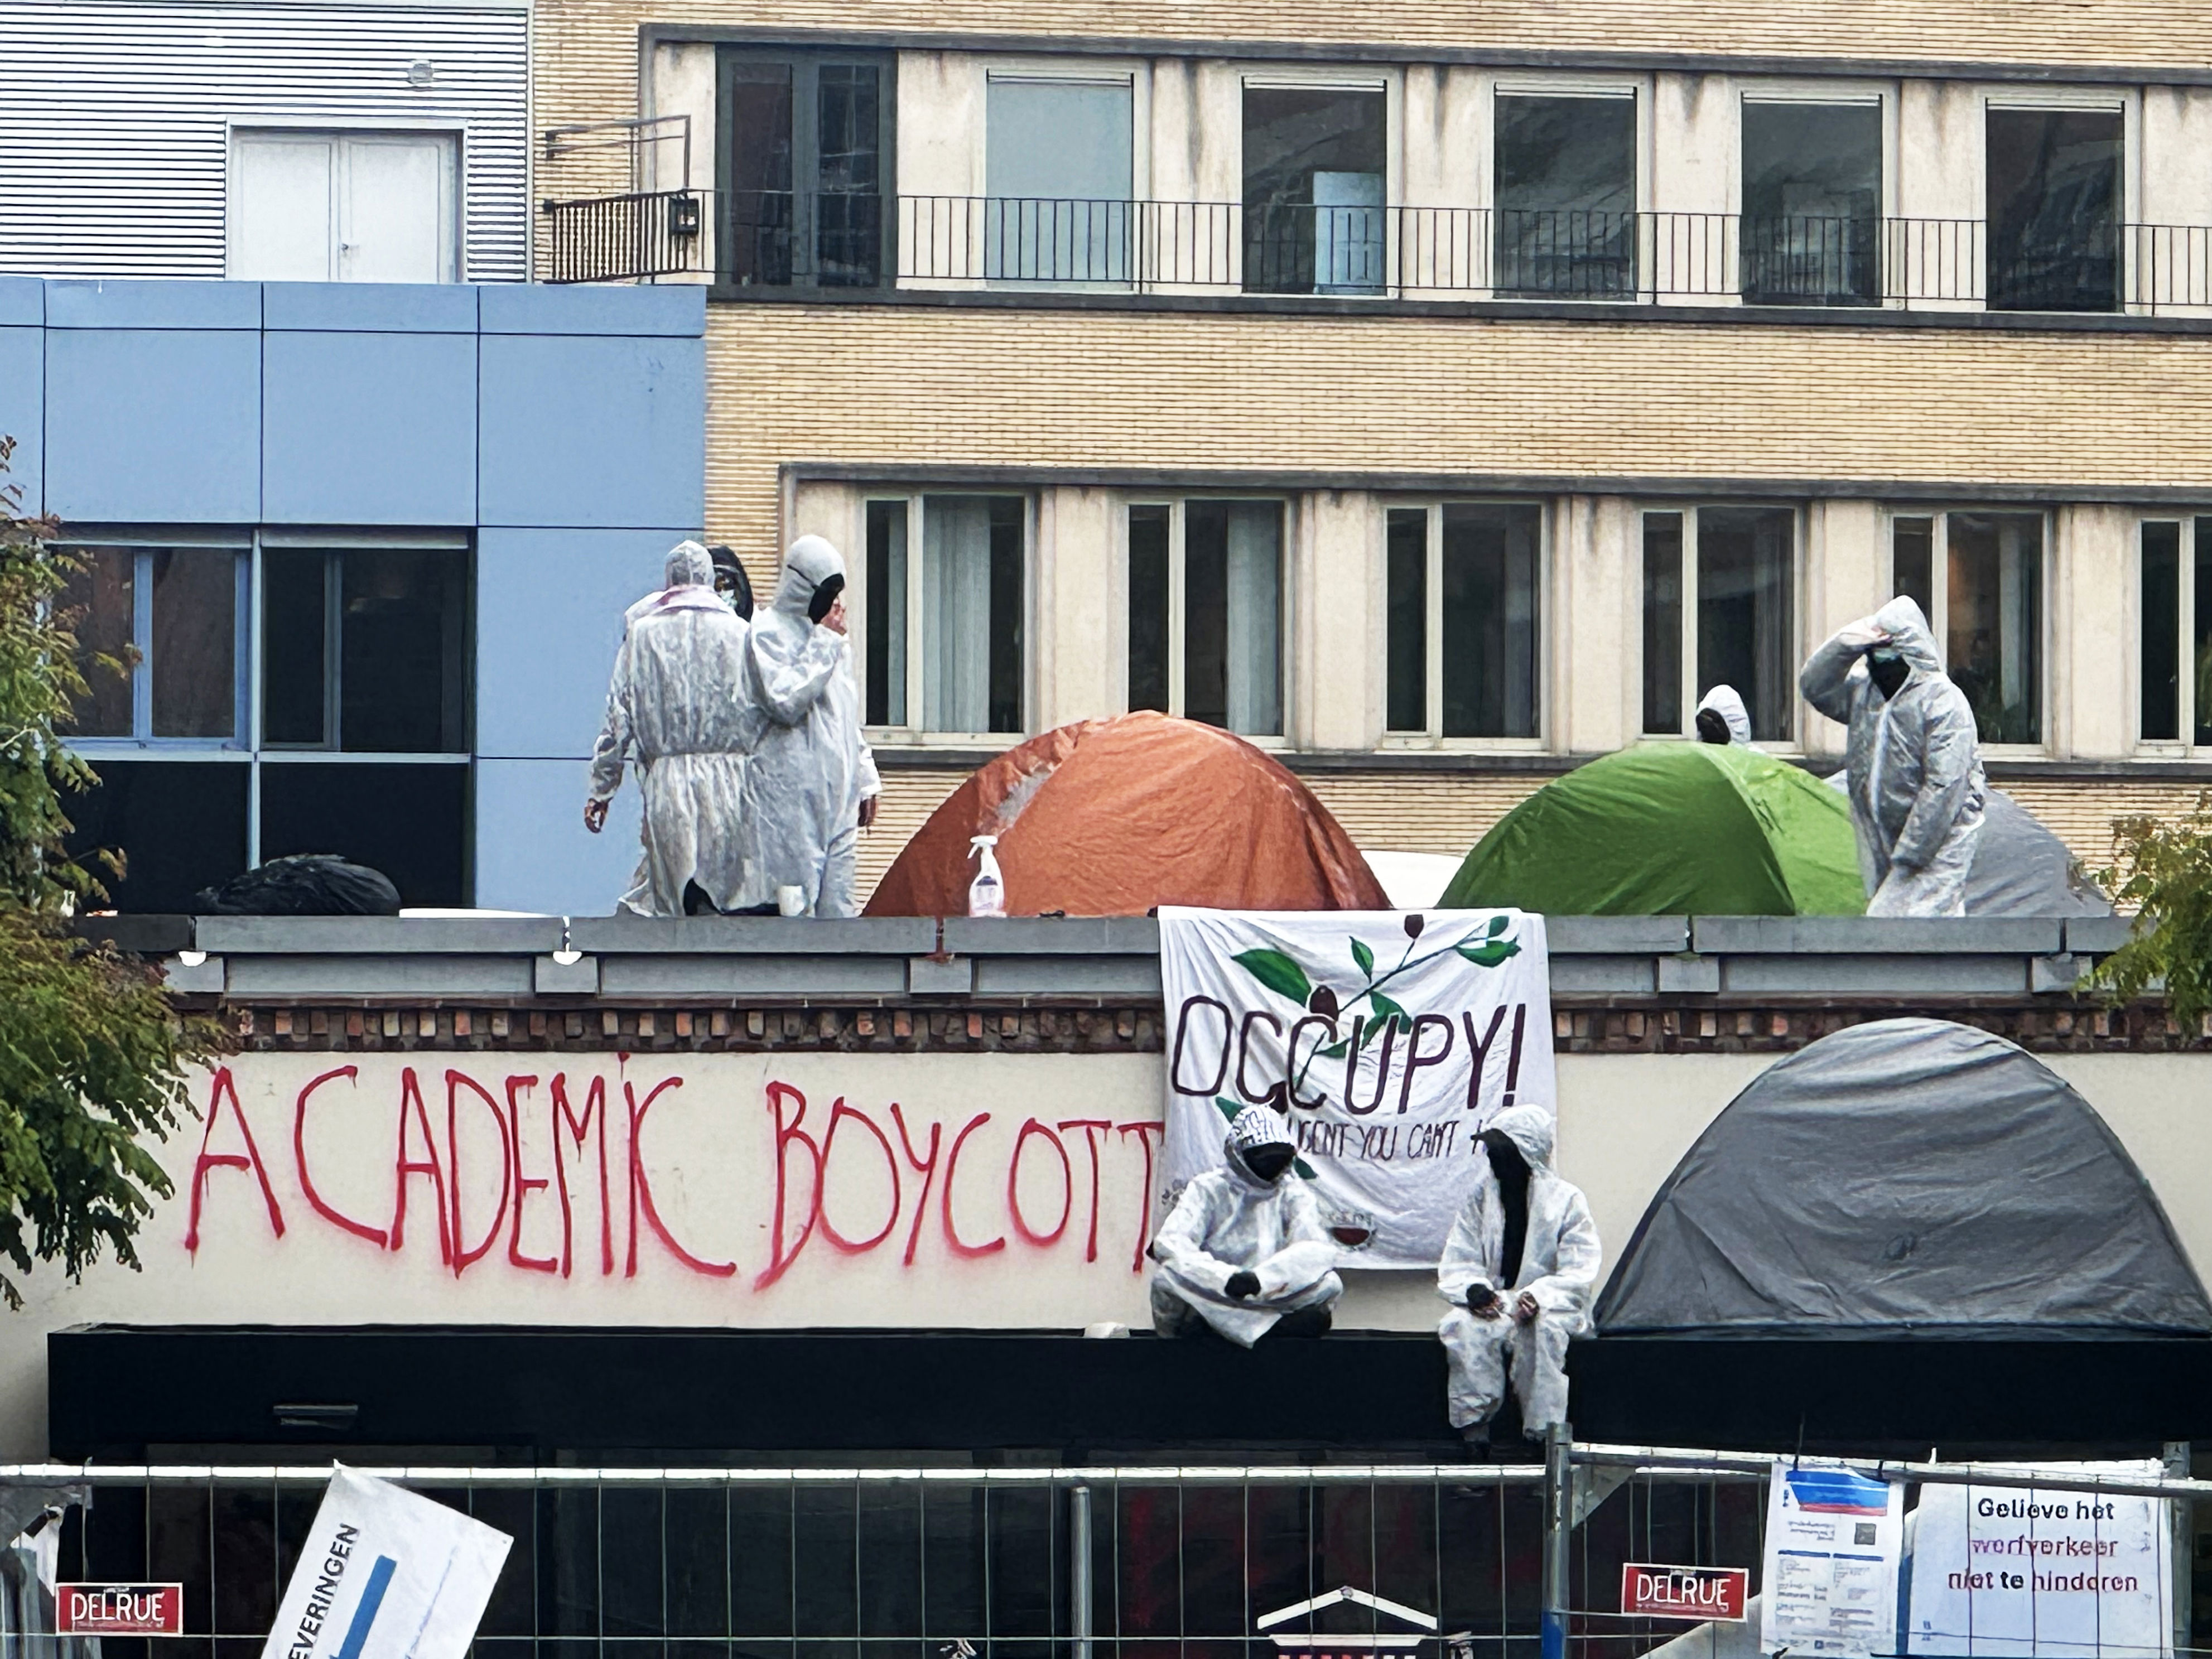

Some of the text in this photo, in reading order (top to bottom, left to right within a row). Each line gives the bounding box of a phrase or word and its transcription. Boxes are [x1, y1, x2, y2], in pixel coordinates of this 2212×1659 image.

[1172, 995, 1526, 1115] OCCUPY!
[1357, 1125, 1398, 1161] YOU
[185, 1052, 1164, 1292] ACADEMIC BOYCOTT
[1978, 1497, 2115, 1520] Gelieve het
[1636, 1574, 1731, 1607] DELRUE
[2000, 1571, 2024, 1589] te
[71, 1592, 165, 1622] DELRUE
